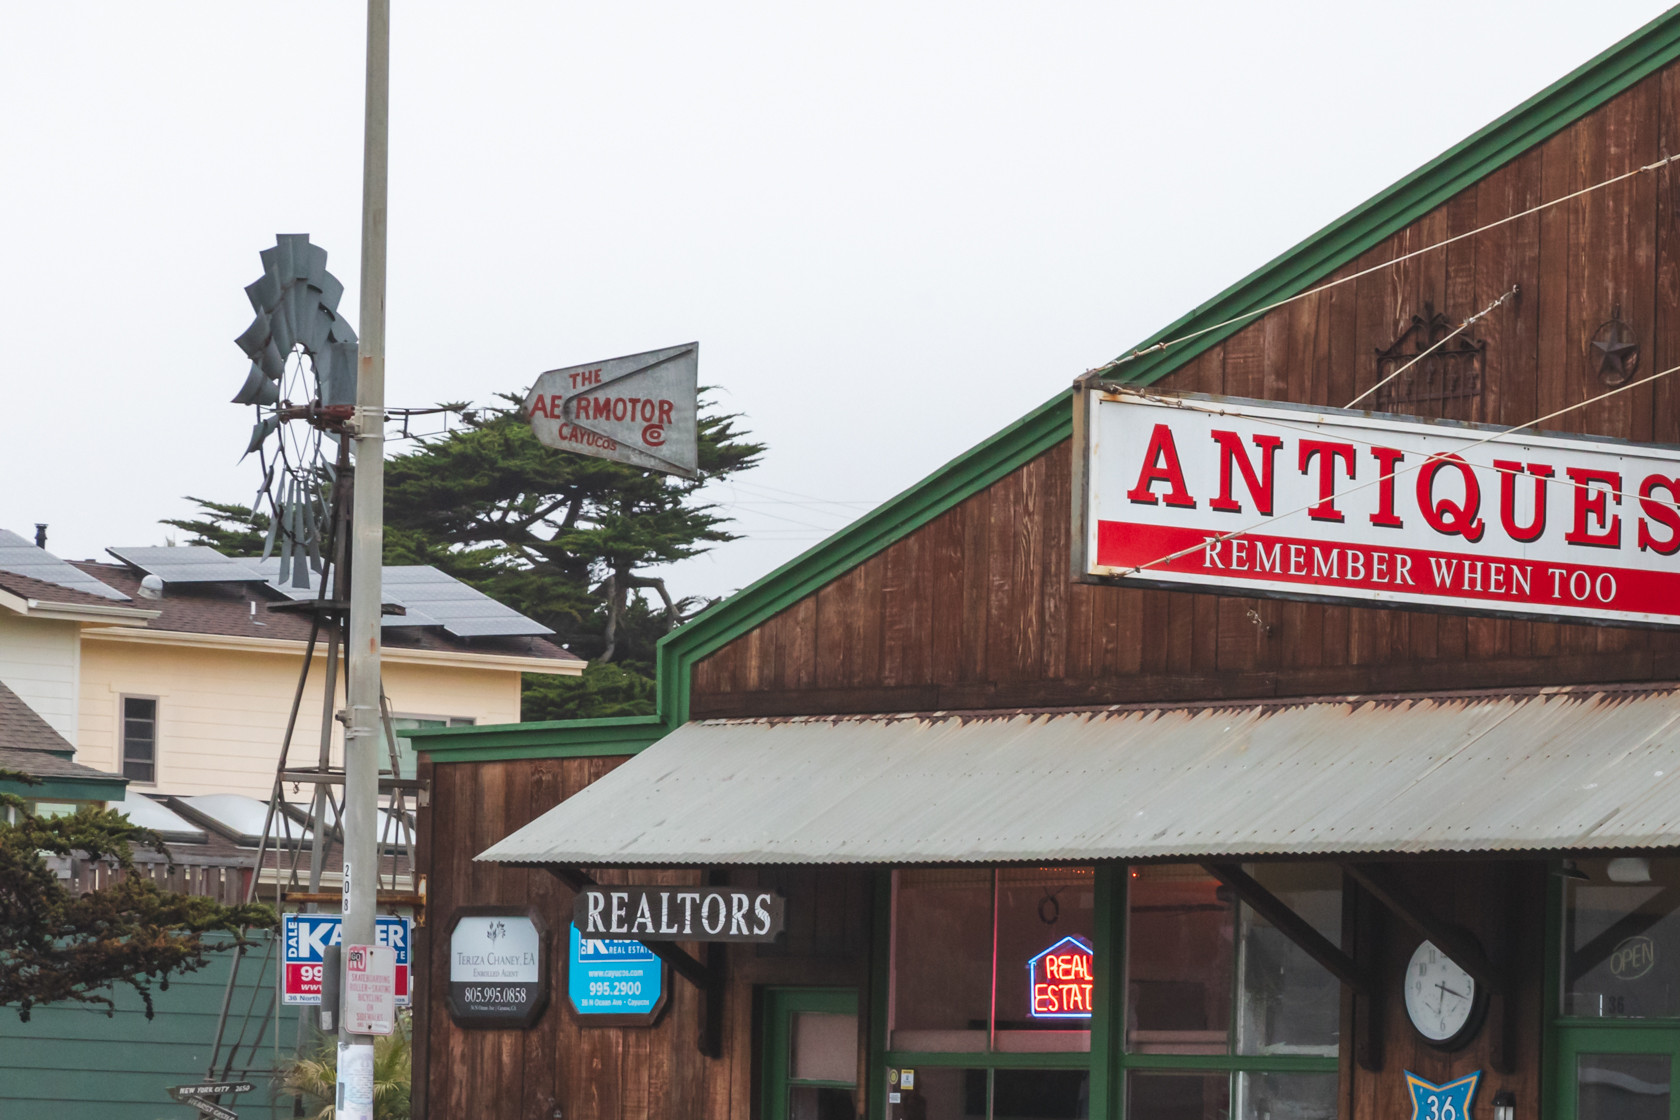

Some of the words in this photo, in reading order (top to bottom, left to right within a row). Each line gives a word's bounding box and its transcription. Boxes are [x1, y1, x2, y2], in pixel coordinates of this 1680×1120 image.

[569, 368, 602, 389] THE
[558, 423, 617, 450] CAYUCOS
[1203, 534, 1415, 586] REMEMBER
[1428, 557, 1532, 596] WHEN
[1548, 569, 1618, 603] TOO
[586, 892, 771, 935] REALTORS
[288, 921, 298, 957] DALE
[299, 923, 406, 958] KAER
[349, 949, 366, 970] NO
[523, 952, 536, 966] EA
[608, 946, 625, 954] REAL
[1610, 941, 1655, 975] OPEN
[588, 970, 644, 978] www.cayucos.com
[1045, 954, 1094, 980] REAL
[351, 973, 391, 984] SKATEBOARDING
[589, 981, 642, 995] 995.2900
[357, 993, 383, 1003] BICYCLING
[464, 987, 527, 1003] 805.995.0858
[627, 999, 650, 1007] Cayucos
[1034, 983, 1094, 1012] ESTAT
[180, 1087, 195, 1095] NEW
[197, 1086, 213, 1094] YORK
